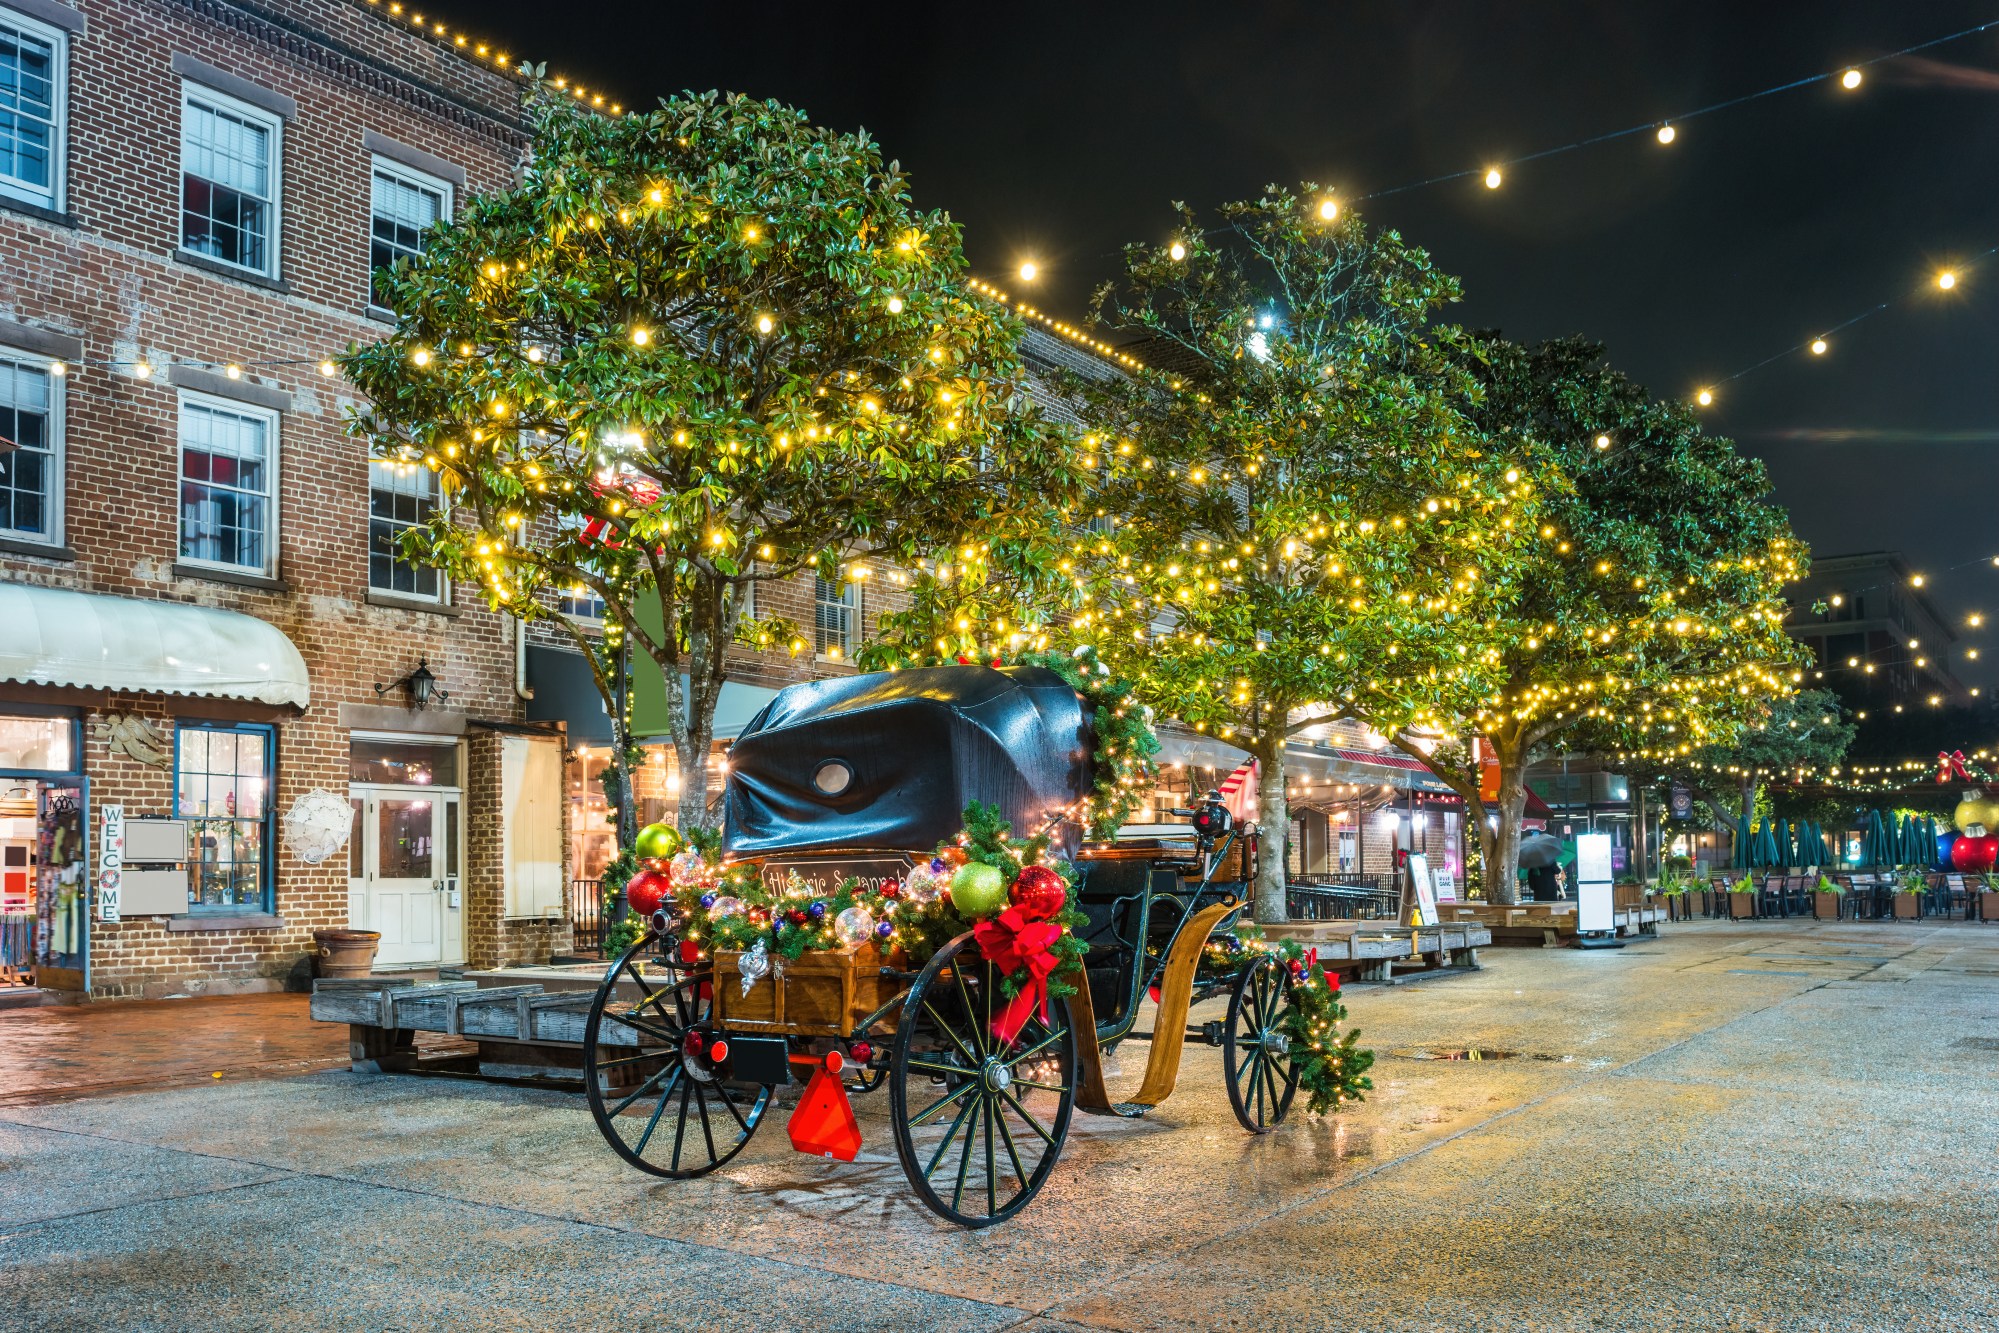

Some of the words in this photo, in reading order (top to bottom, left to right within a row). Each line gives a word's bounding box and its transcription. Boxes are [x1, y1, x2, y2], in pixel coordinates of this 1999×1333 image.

[100, 808, 120, 919] WELCOME
[769, 872, 828, 897] Hiric
[833, 868, 906, 895] Sanh
